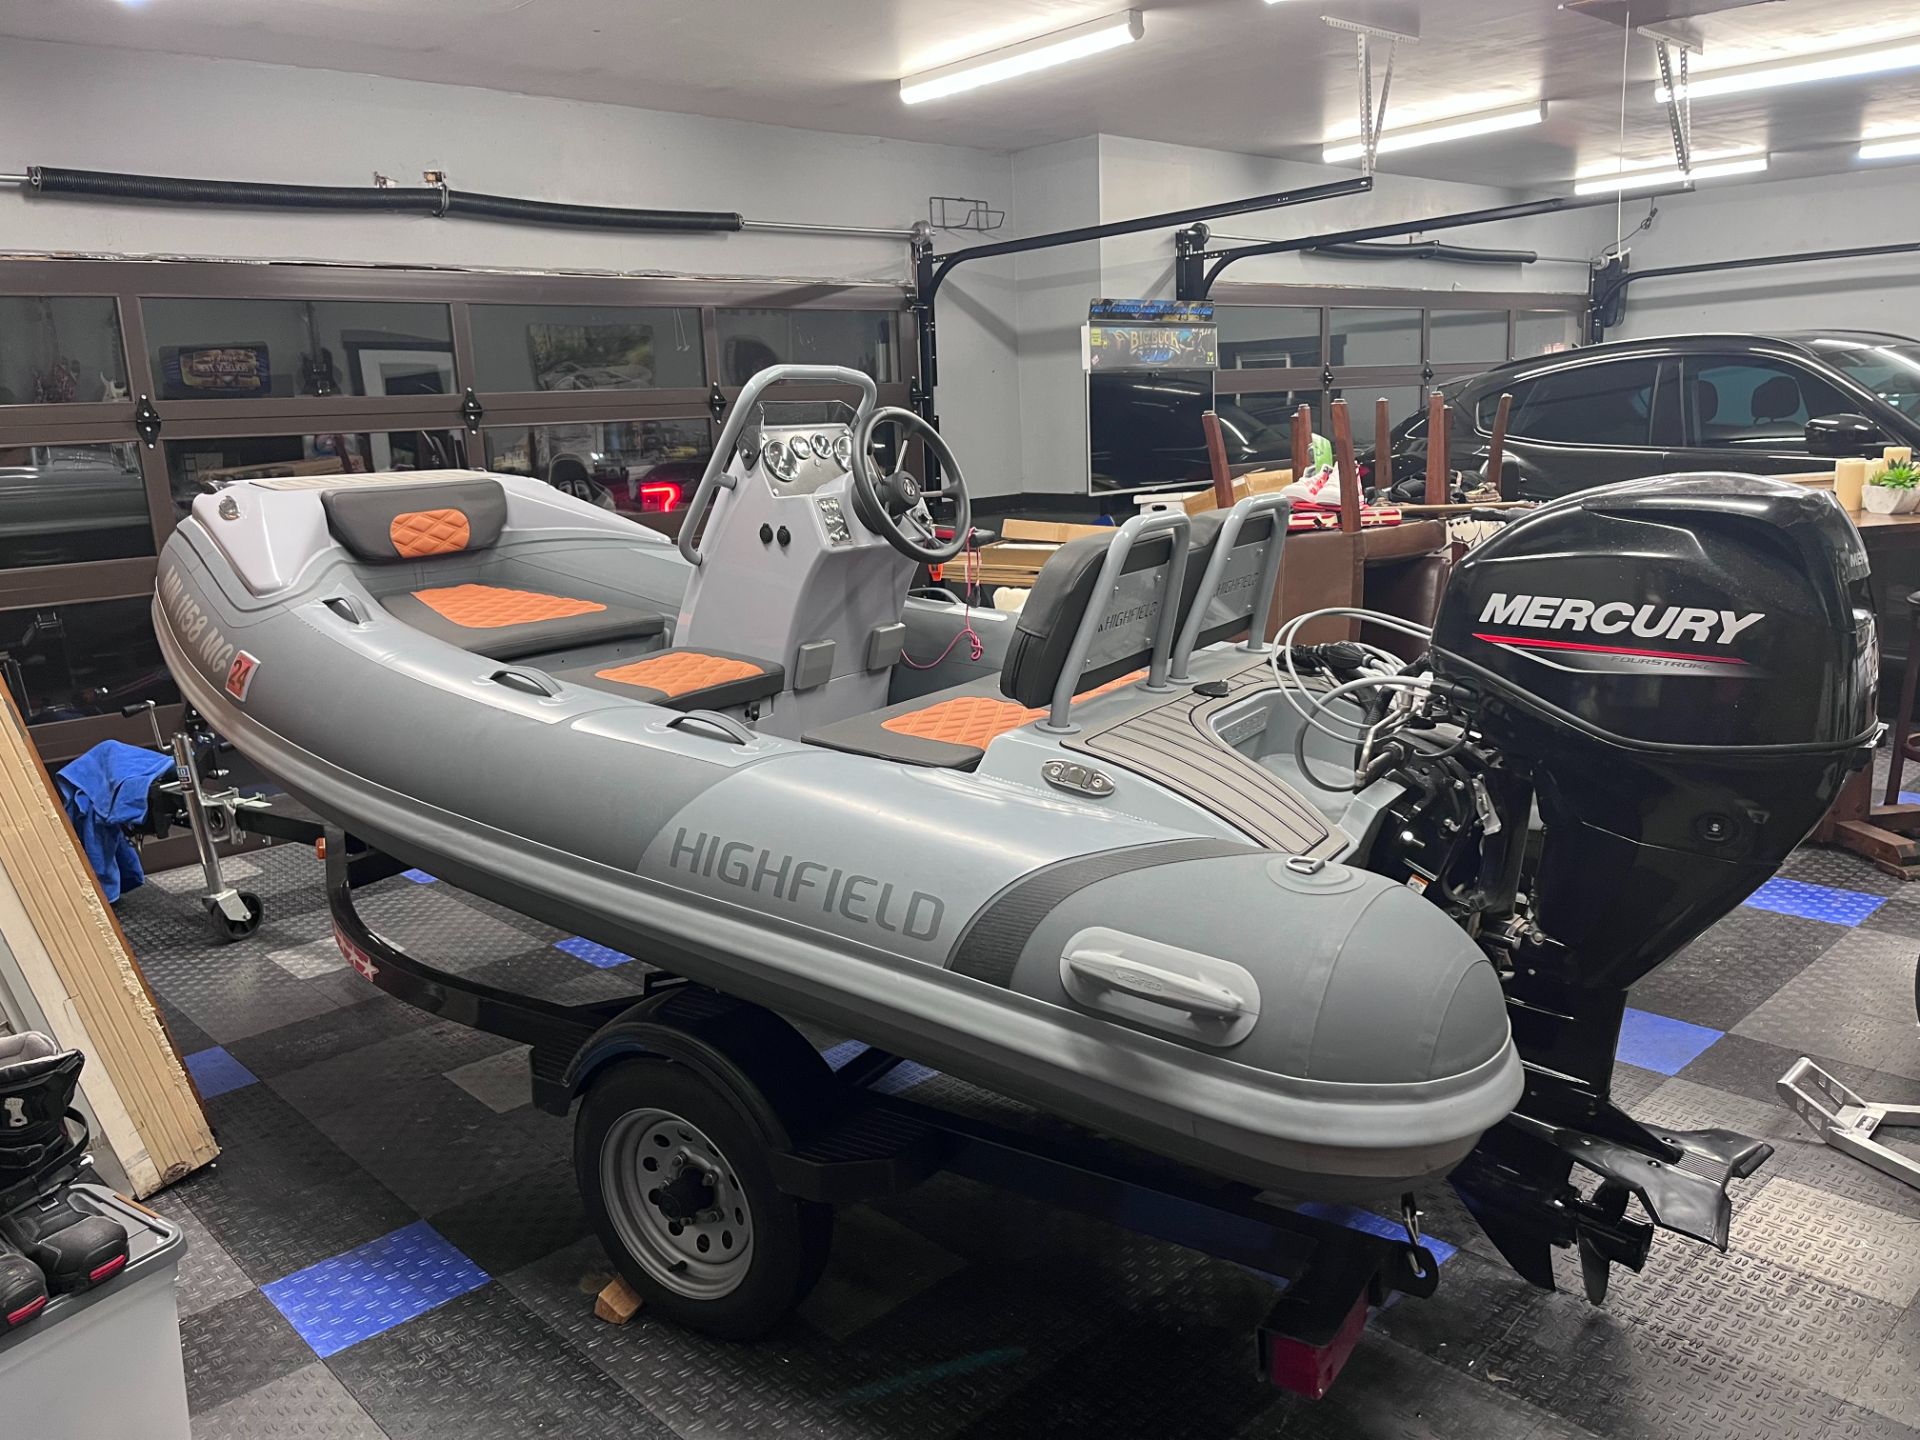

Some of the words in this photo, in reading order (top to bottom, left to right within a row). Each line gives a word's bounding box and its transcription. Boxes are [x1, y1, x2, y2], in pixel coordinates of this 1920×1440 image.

[1130, 331, 1150, 350] BIG
[1150, 330, 1180, 350] BUCK
[174, 593, 208, 643] 1158
[199, 626, 234, 673] MG
[1104, 601, 1159, 632] HIGHFIELD
[1478, 592, 1766, 645] MERCURY
[228, 659, 251, 693] 24
[669, 827, 945, 942] HIGHFIELD
